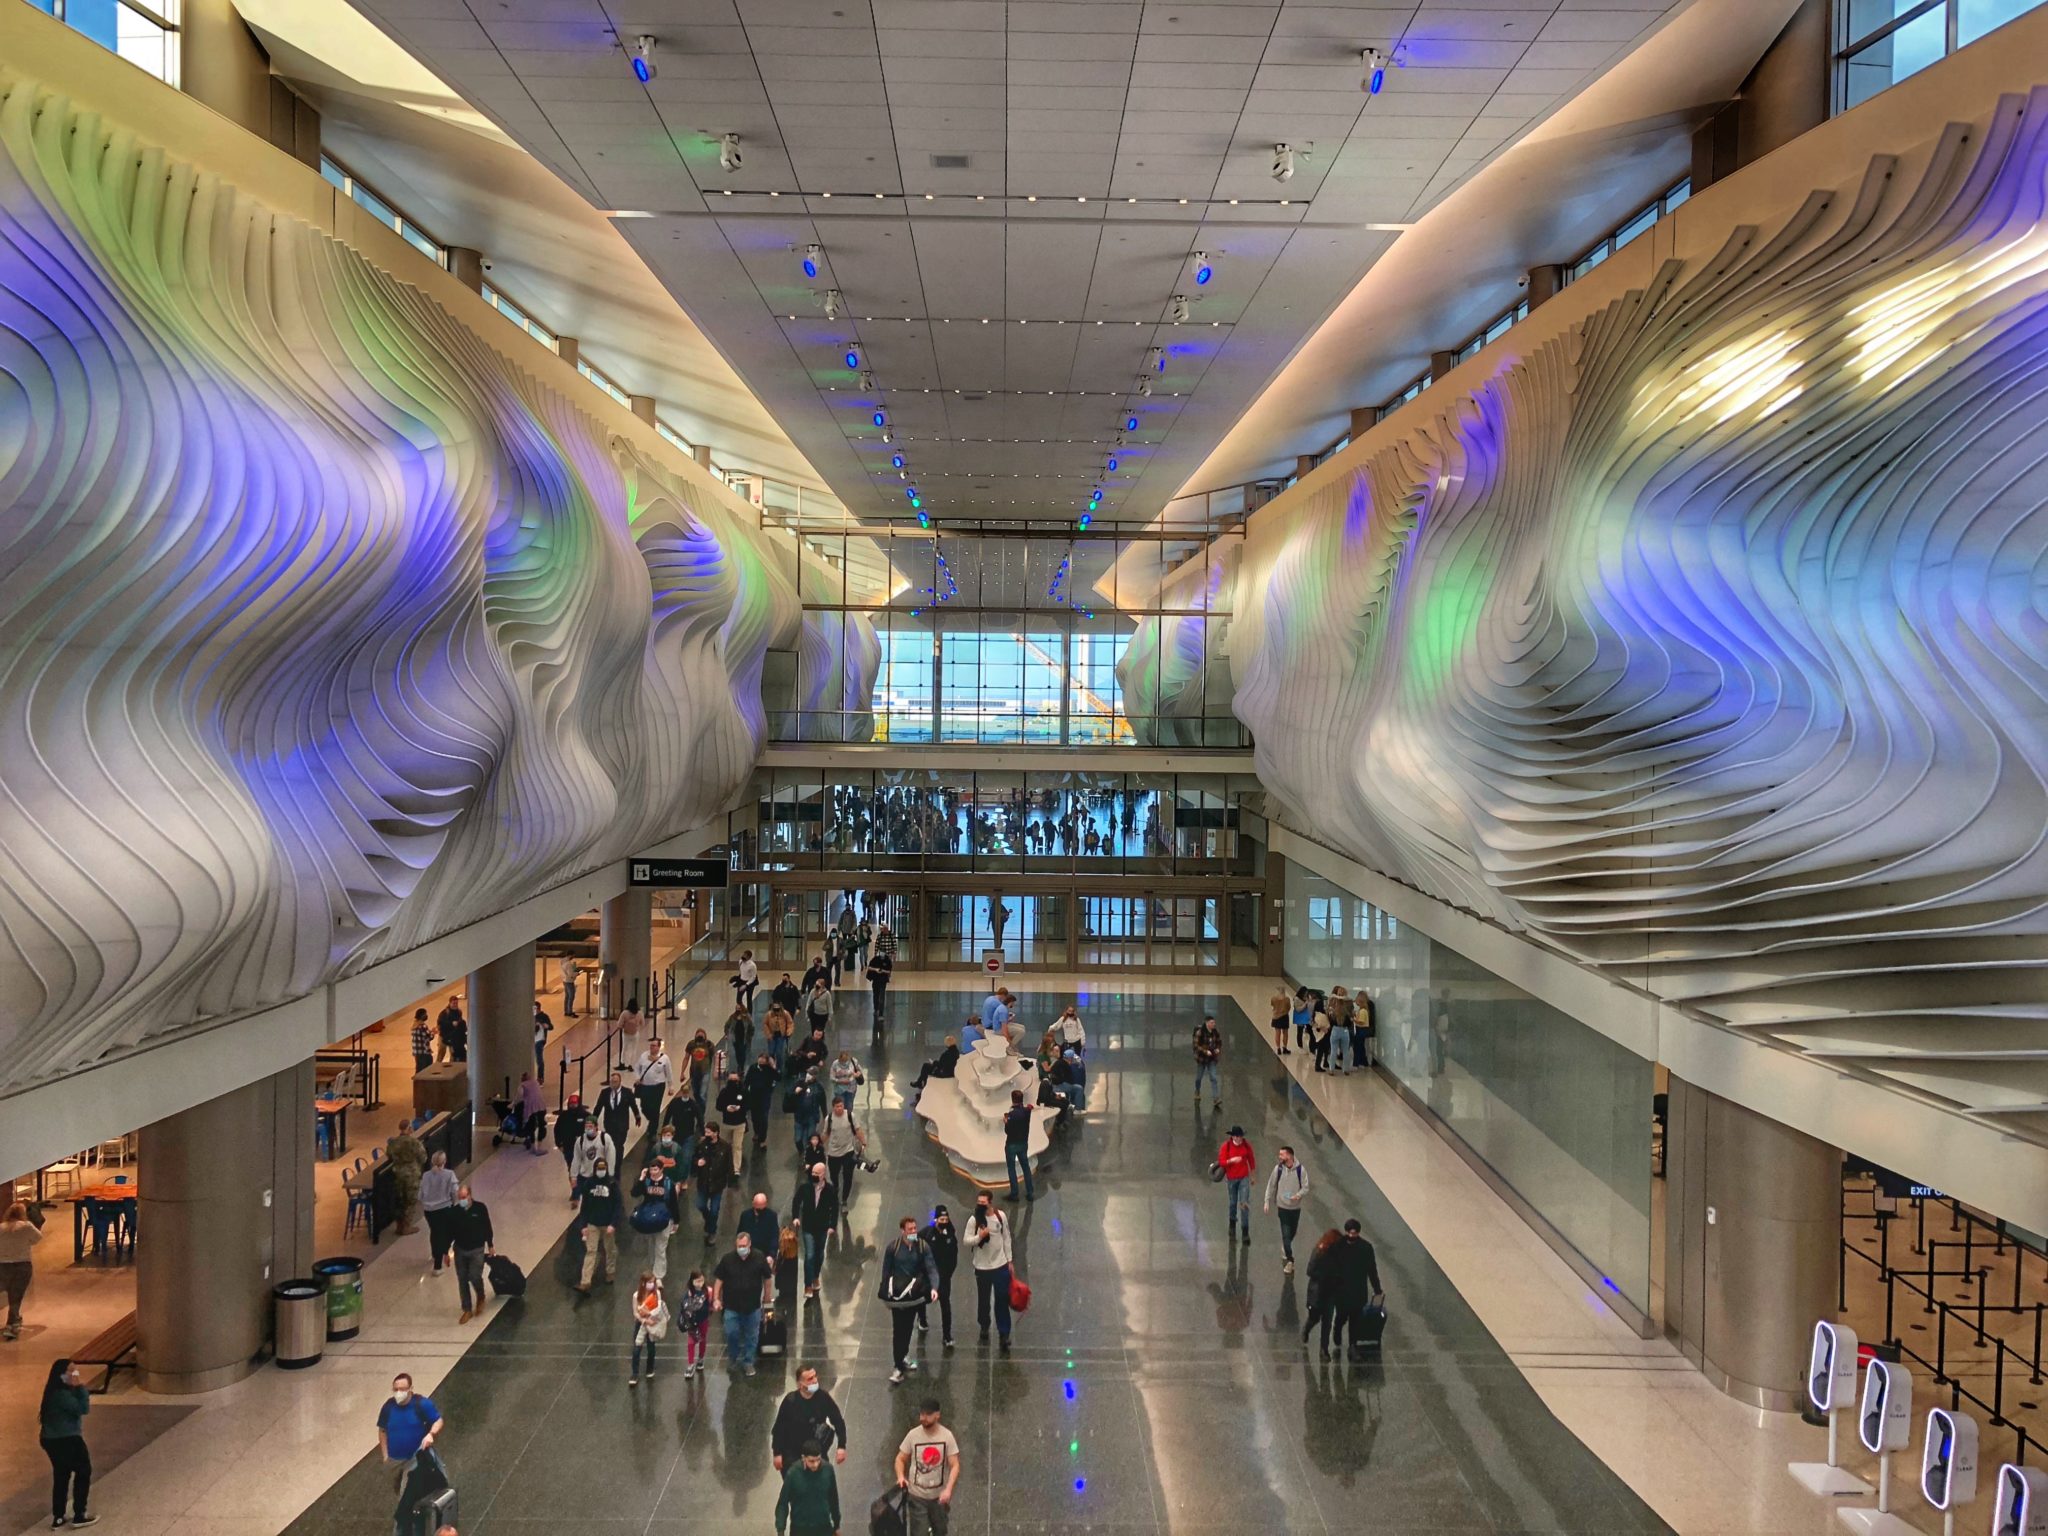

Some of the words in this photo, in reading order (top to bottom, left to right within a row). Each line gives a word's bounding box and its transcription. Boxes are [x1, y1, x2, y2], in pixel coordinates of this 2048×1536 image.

[652, 869, 682, 878] Greeting
[684, 869, 704, 877] Room
[1910, 1186, 1931, 1195] EXIT
